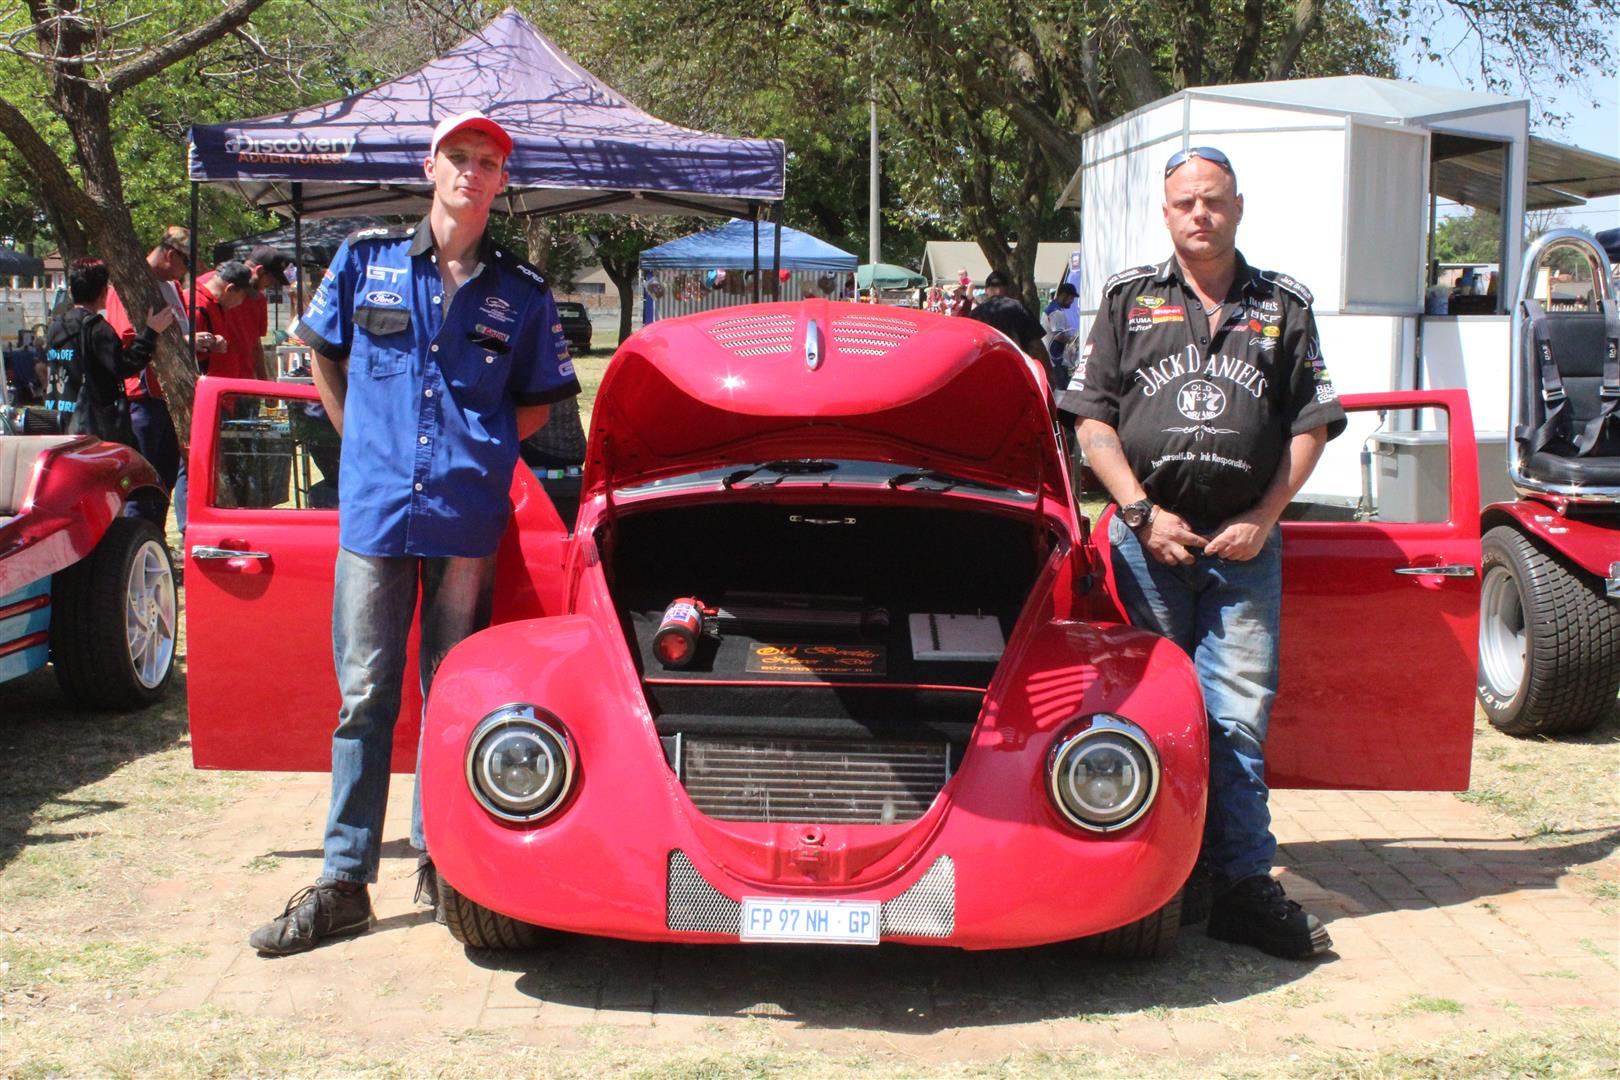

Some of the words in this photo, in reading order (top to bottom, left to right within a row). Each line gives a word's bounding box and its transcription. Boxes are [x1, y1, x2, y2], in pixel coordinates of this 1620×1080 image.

[236, 135, 356, 155] Discovery
[366, 265, 408, 284] GT
[1135, 352, 1185, 397] JACK
[750, 908, 773, 931] FP
[779, 908, 800, 932] 97
[806, 909, 829, 933] NH
[848, 911, 871, 934] GP
